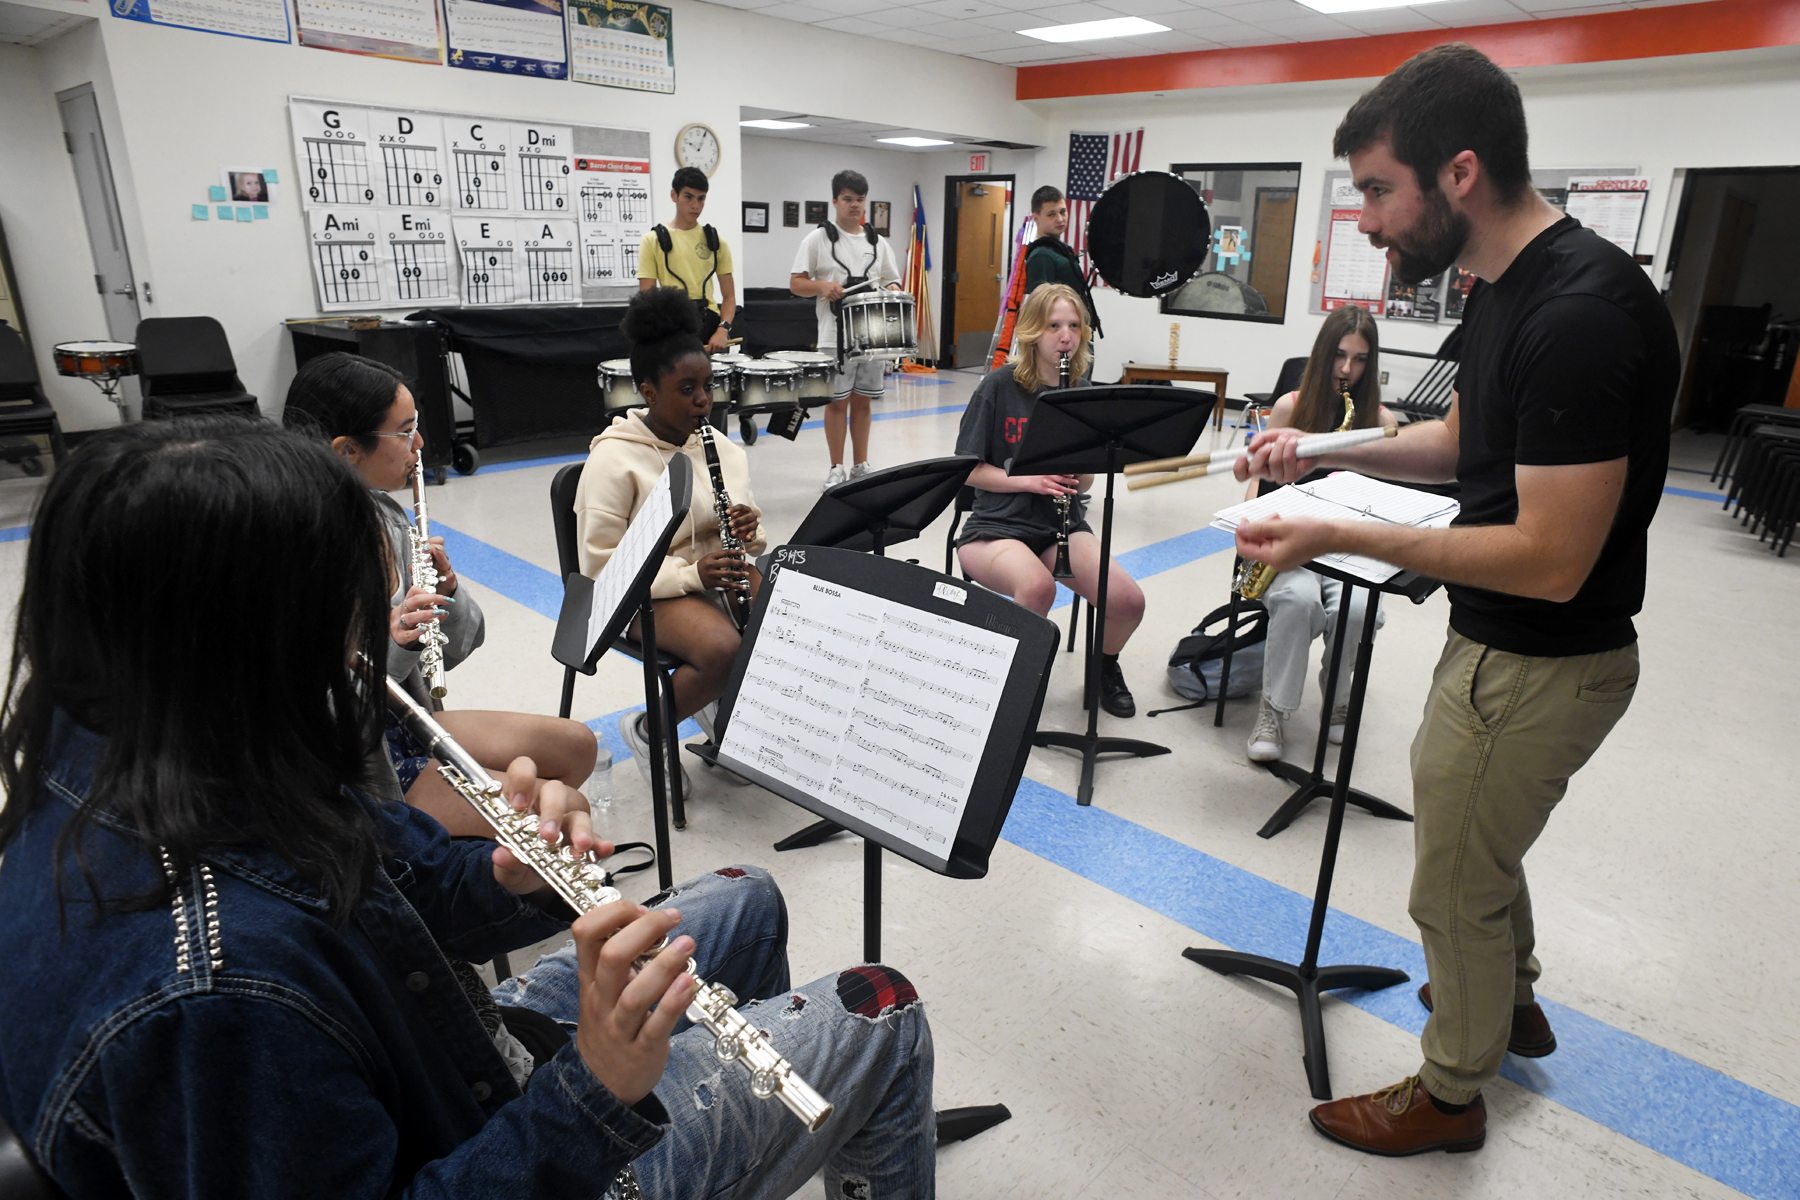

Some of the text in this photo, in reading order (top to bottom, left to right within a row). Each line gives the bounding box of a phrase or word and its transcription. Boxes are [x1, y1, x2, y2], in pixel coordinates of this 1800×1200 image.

[323, 110, 340, 128] G
[398, 116, 414, 134] D
[470, 124, 484, 141] C
[971, 155, 985, 171] EXIT
[480, 223, 490, 238] E
[542, 224, 553, 239] A
[1156, 274, 1177, 288] REMO
[775, 549, 806, 564] SHS
[813, 584, 841, 598] BLUE BOSSA
